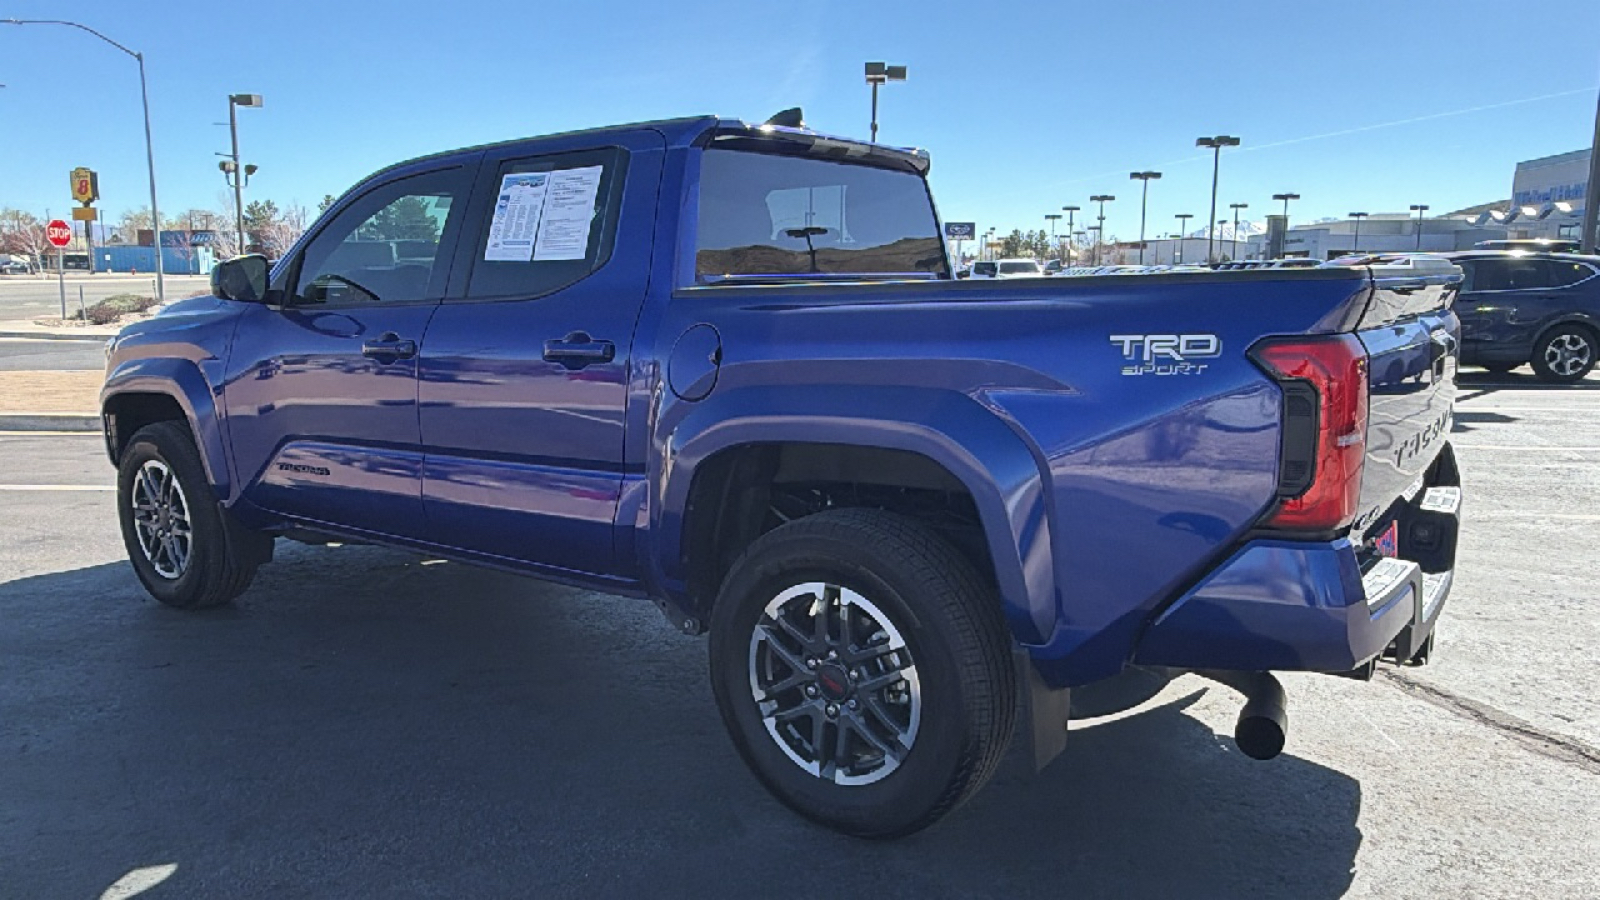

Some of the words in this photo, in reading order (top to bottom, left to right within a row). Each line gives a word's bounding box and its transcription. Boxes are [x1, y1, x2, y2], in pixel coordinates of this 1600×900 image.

[77, 179, 89, 195] 8
[49, 226, 70, 240] STOP
[1109, 334, 1219, 360] TRD
[1121, 363, 1208, 376] SPORT
